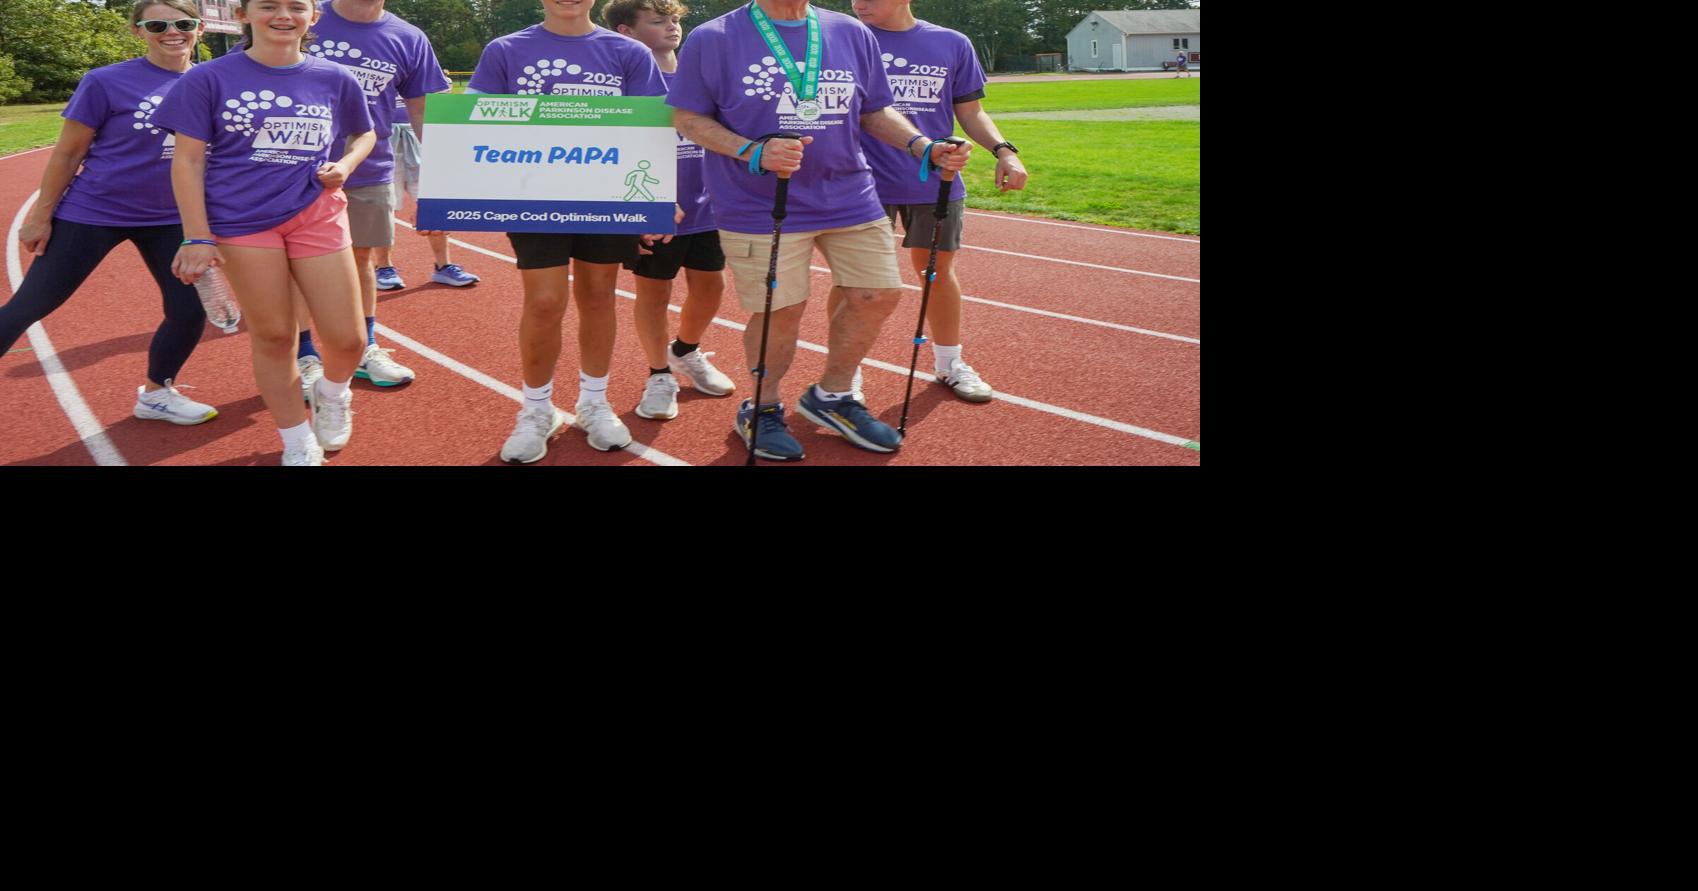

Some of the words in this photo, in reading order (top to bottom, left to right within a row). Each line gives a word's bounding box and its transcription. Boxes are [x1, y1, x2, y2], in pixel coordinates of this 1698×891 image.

[360, 57, 397, 73] 2025
[909, 64, 948, 77] 2025
[583, 71, 623, 87] 2025
[890, 79, 937, 87] PTIMISM
[551, 87, 614, 97] OPTIMISM
[473, 145, 543, 164] Team
[547, 146, 619, 165] PAPA
[447, 211, 481, 220] 2025
[483, 211, 518, 223] Cape
[520, 211, 548, 221] Cod
[550, 212, 611, 223] Optimism
[613, 213, 648, 223] Walk
